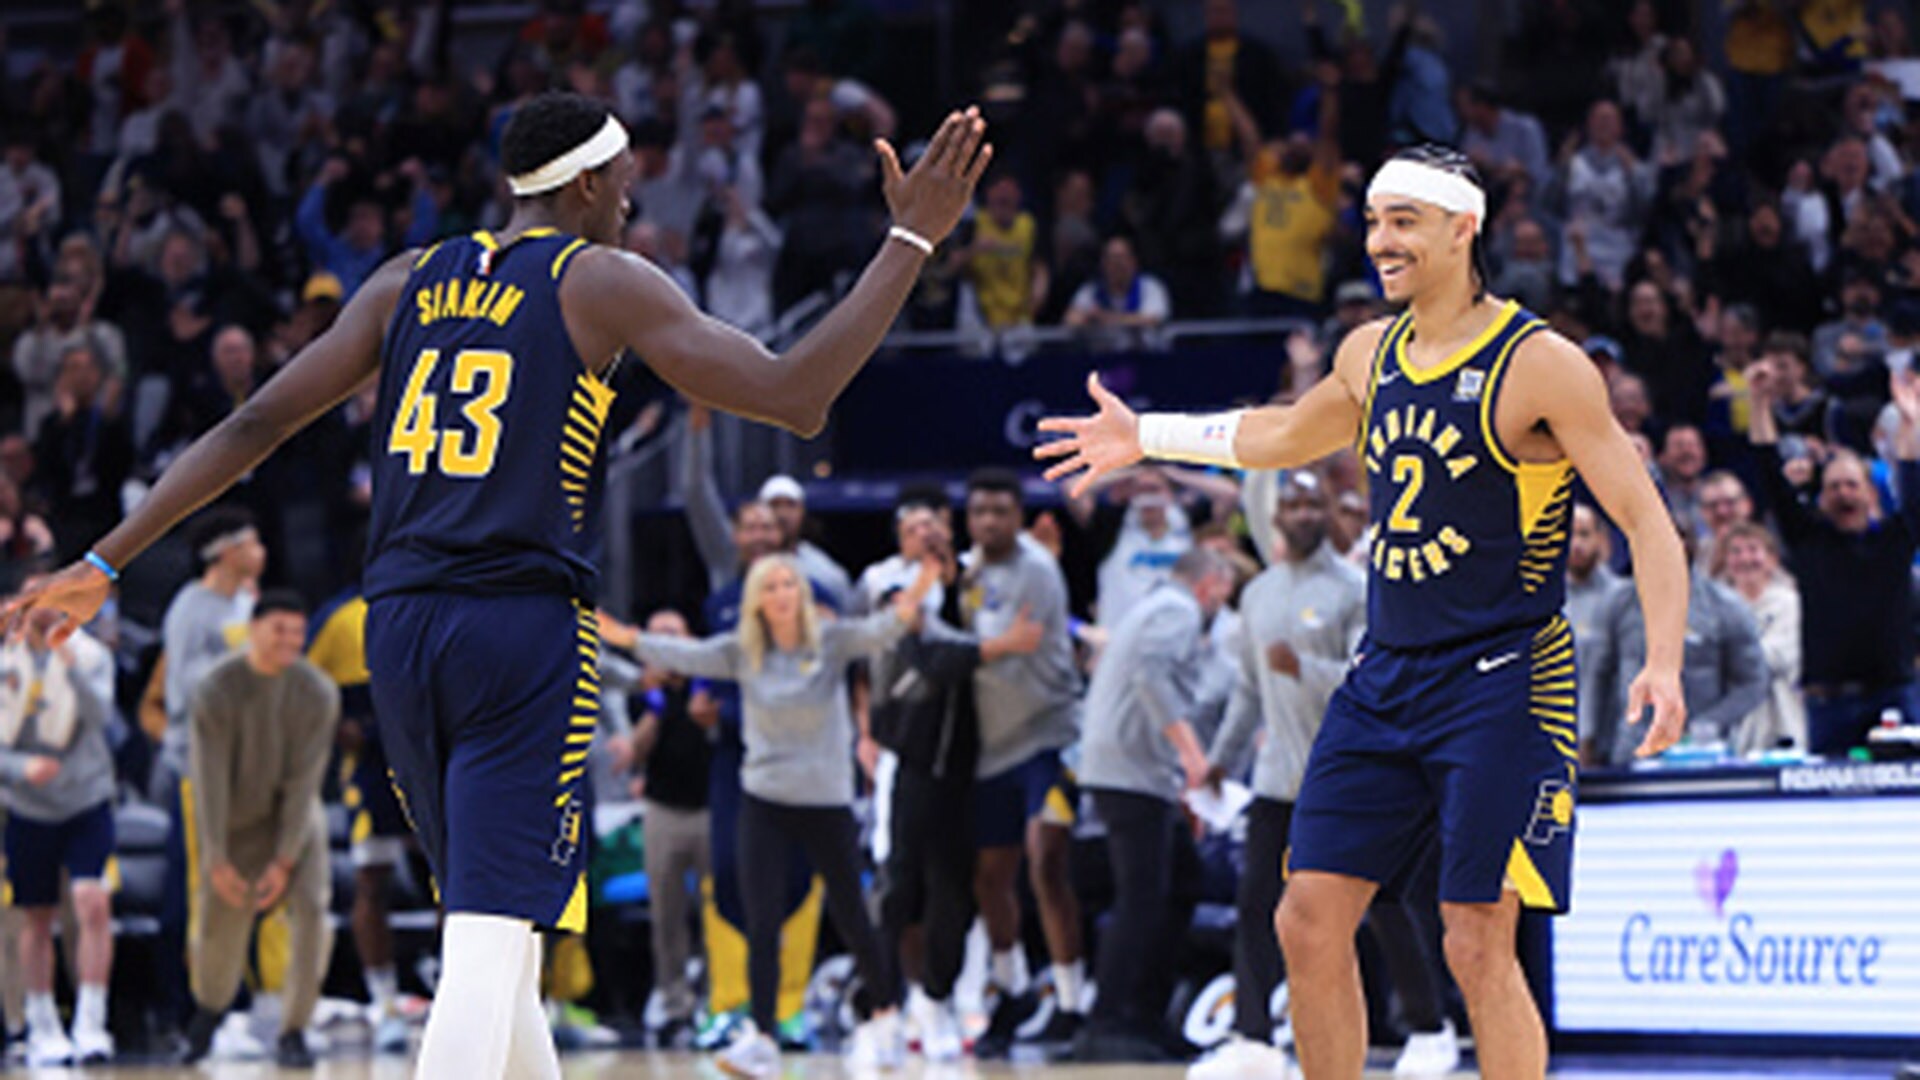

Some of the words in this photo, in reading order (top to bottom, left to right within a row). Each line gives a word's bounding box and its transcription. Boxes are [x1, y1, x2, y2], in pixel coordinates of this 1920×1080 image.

[388, 348, 513, 478] 43
[1388, 455, 1424, 532] 2
[1620, 912, 1882, 986] CareSource
